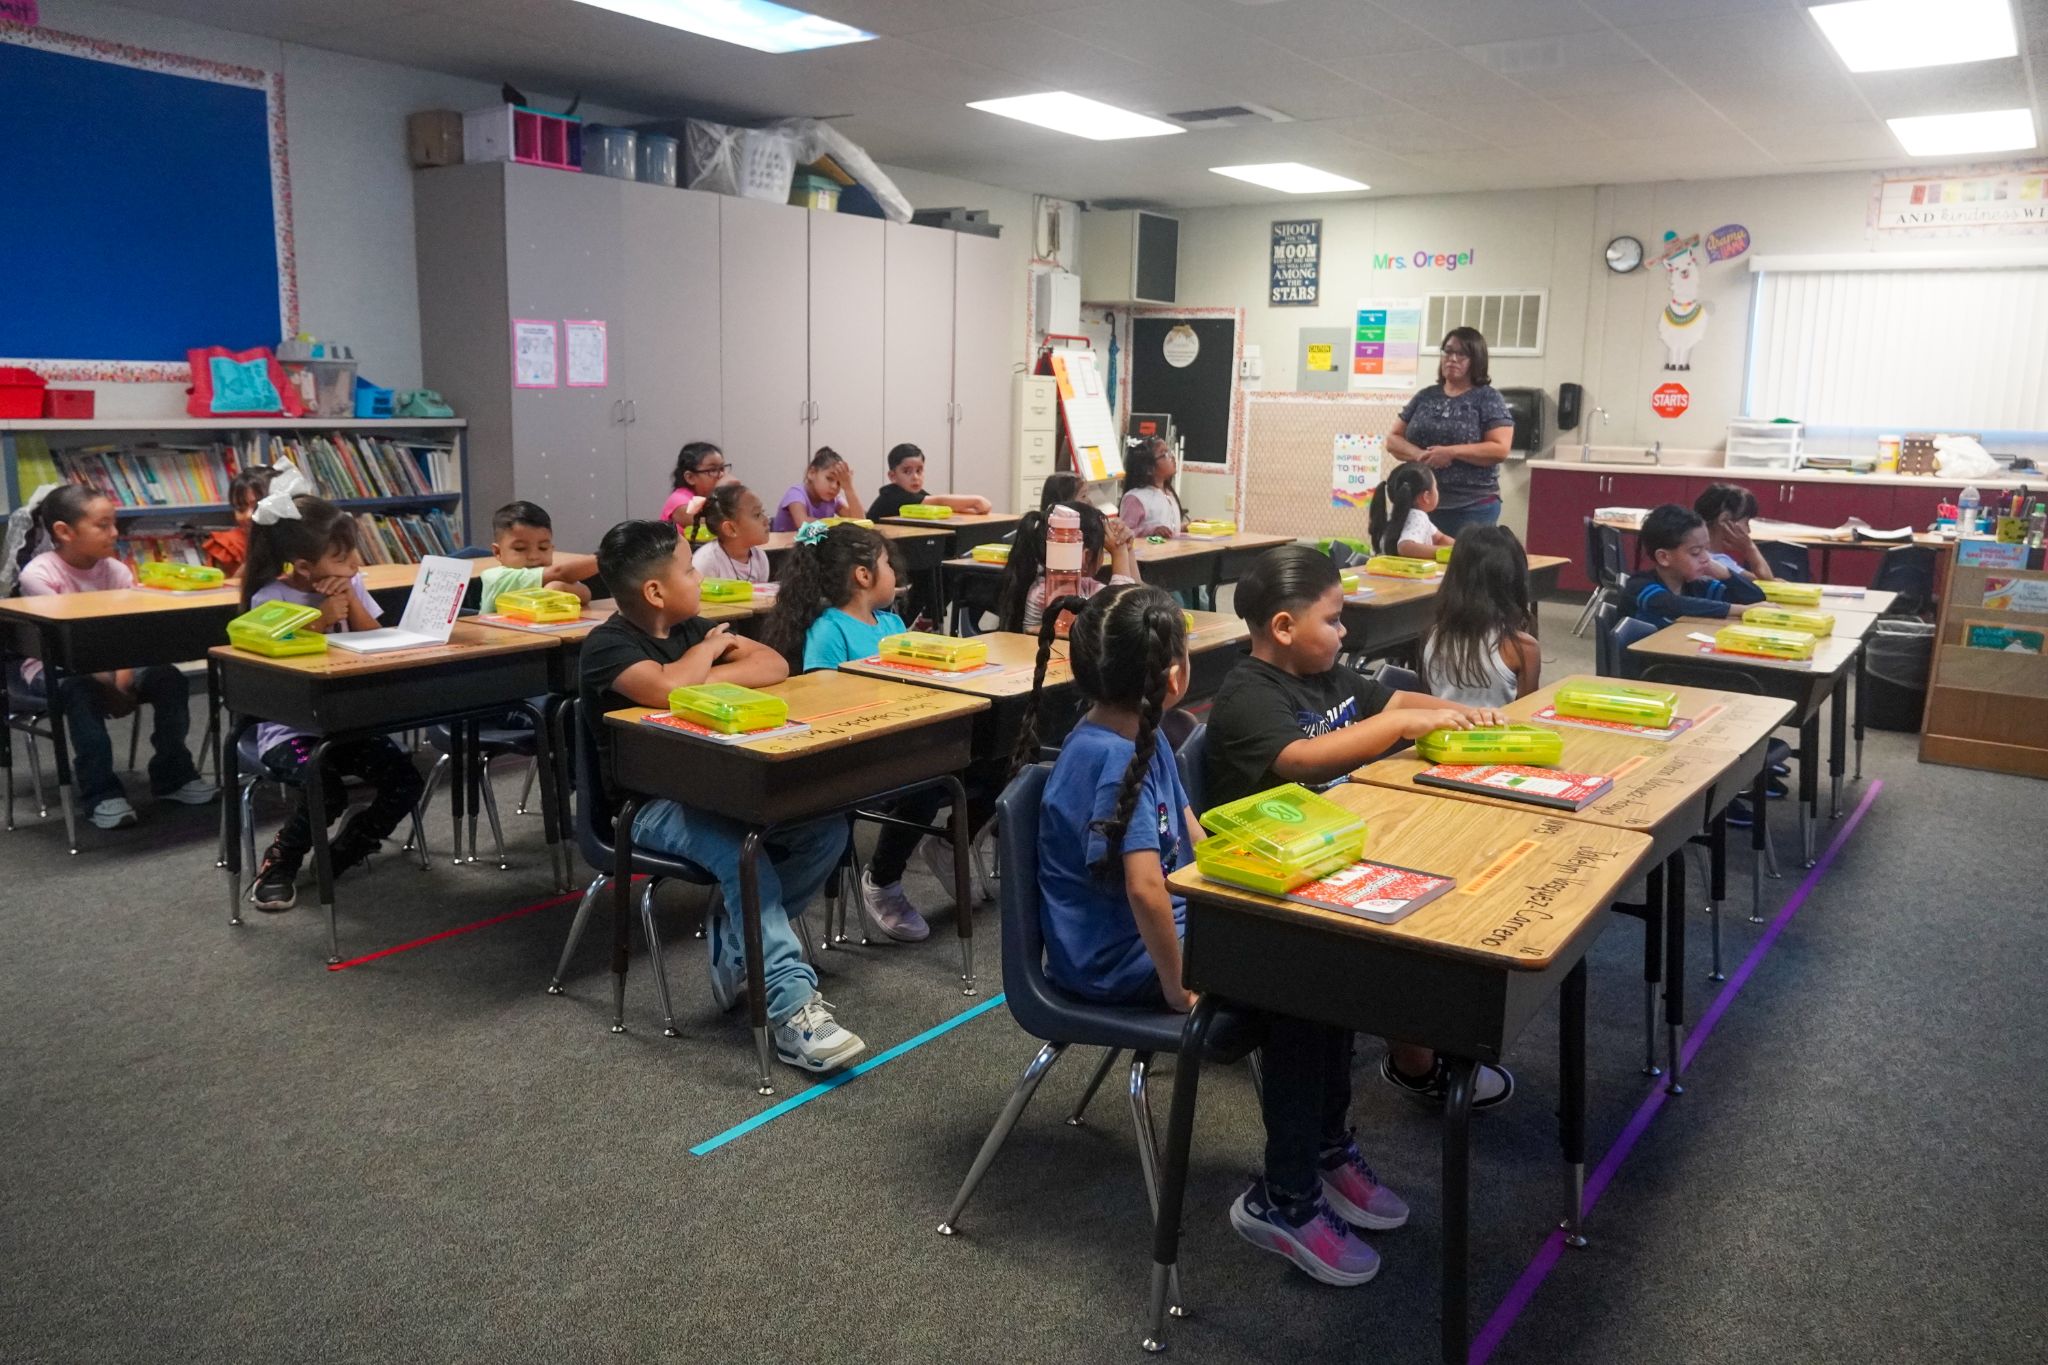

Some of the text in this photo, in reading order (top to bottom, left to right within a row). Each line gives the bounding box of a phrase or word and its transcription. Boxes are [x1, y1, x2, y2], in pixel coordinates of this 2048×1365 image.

[1896, 213, 1934, 224] AND
[1274, 223, 1316, 236] SHOOT
[1274, 244, 1317, 258] MOON
[1413, 248, 1474, 271] Oregel
[1274, 268, 1316, 279] AMONG
[1272, 286, 1316, 301] STARS
[1653, 393, 1688, 407] STARTS
[1337, 464, 1349, 472] TO
[1348, 475, 1365, 484] BIG
[1553, 846, 1618, 873] Jakelyn
